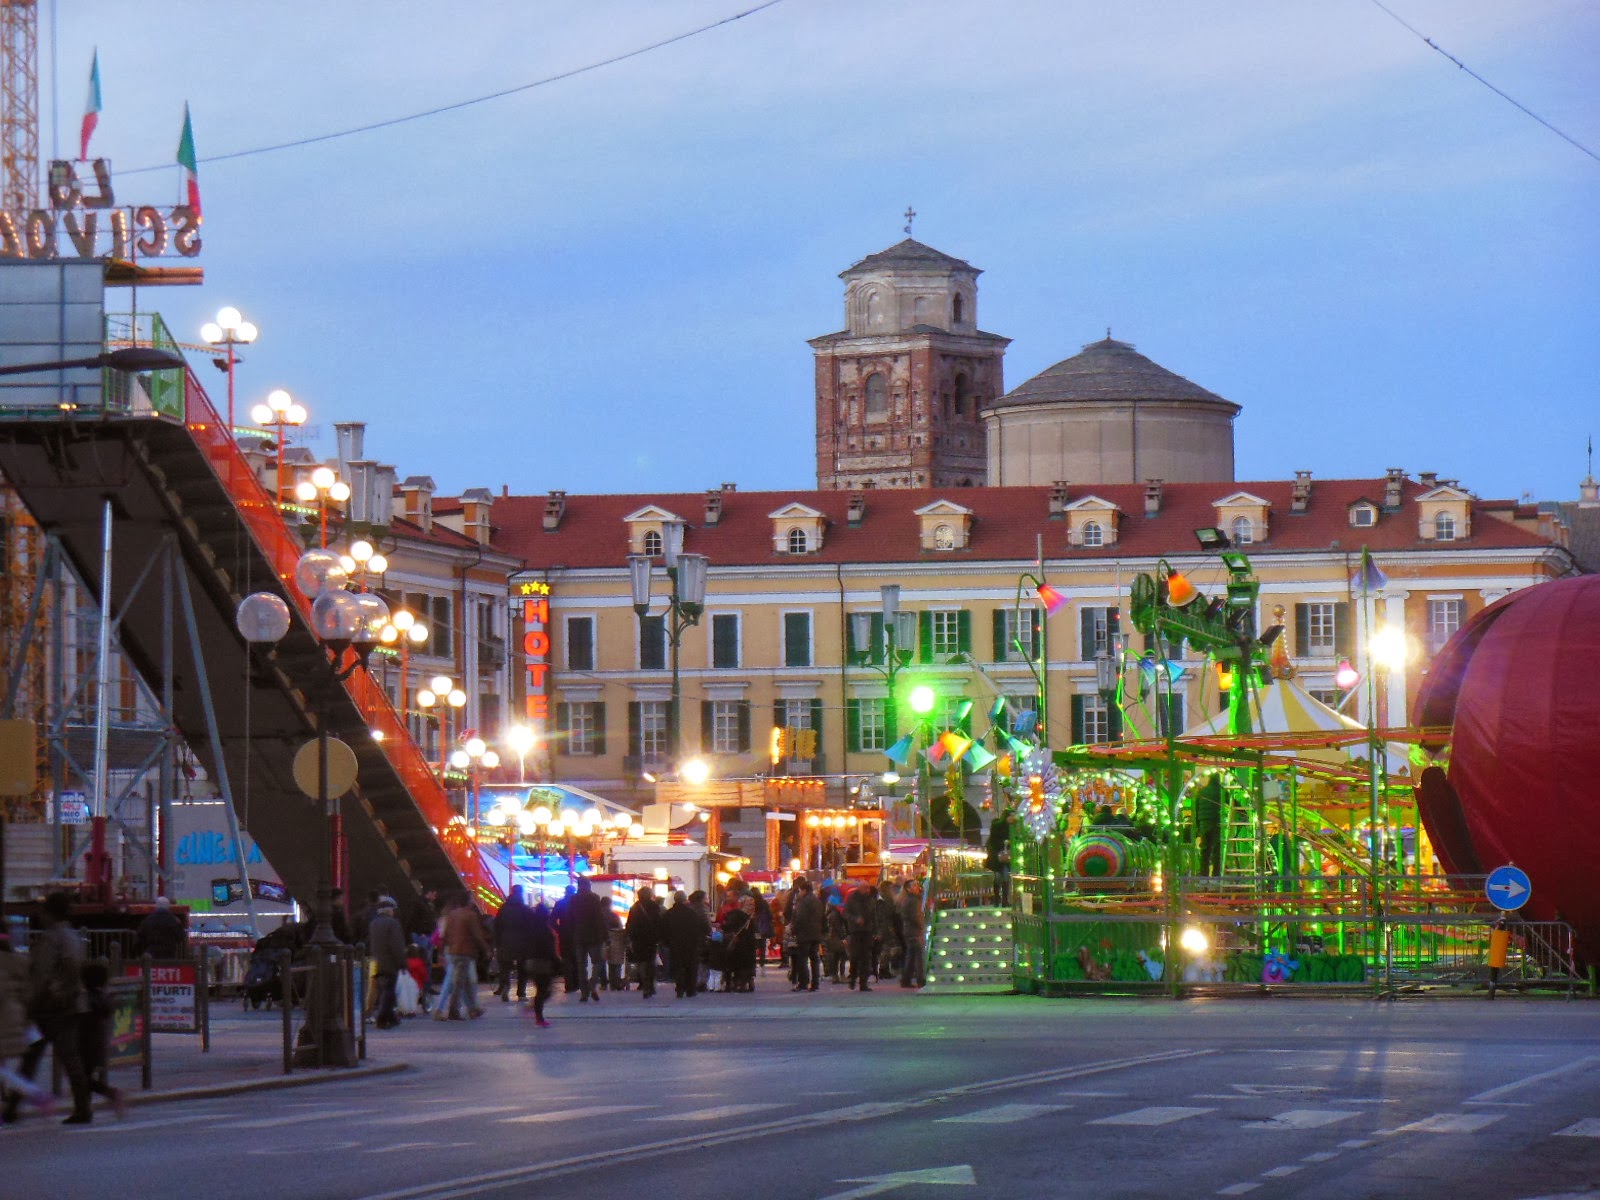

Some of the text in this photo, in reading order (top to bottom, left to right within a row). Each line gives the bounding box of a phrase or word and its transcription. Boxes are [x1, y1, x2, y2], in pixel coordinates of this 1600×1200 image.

[524, 599, 550, 750] HOTE
[138, 967, 181, 982] ERTI
[150, 985, 192, 996] IFURTI
